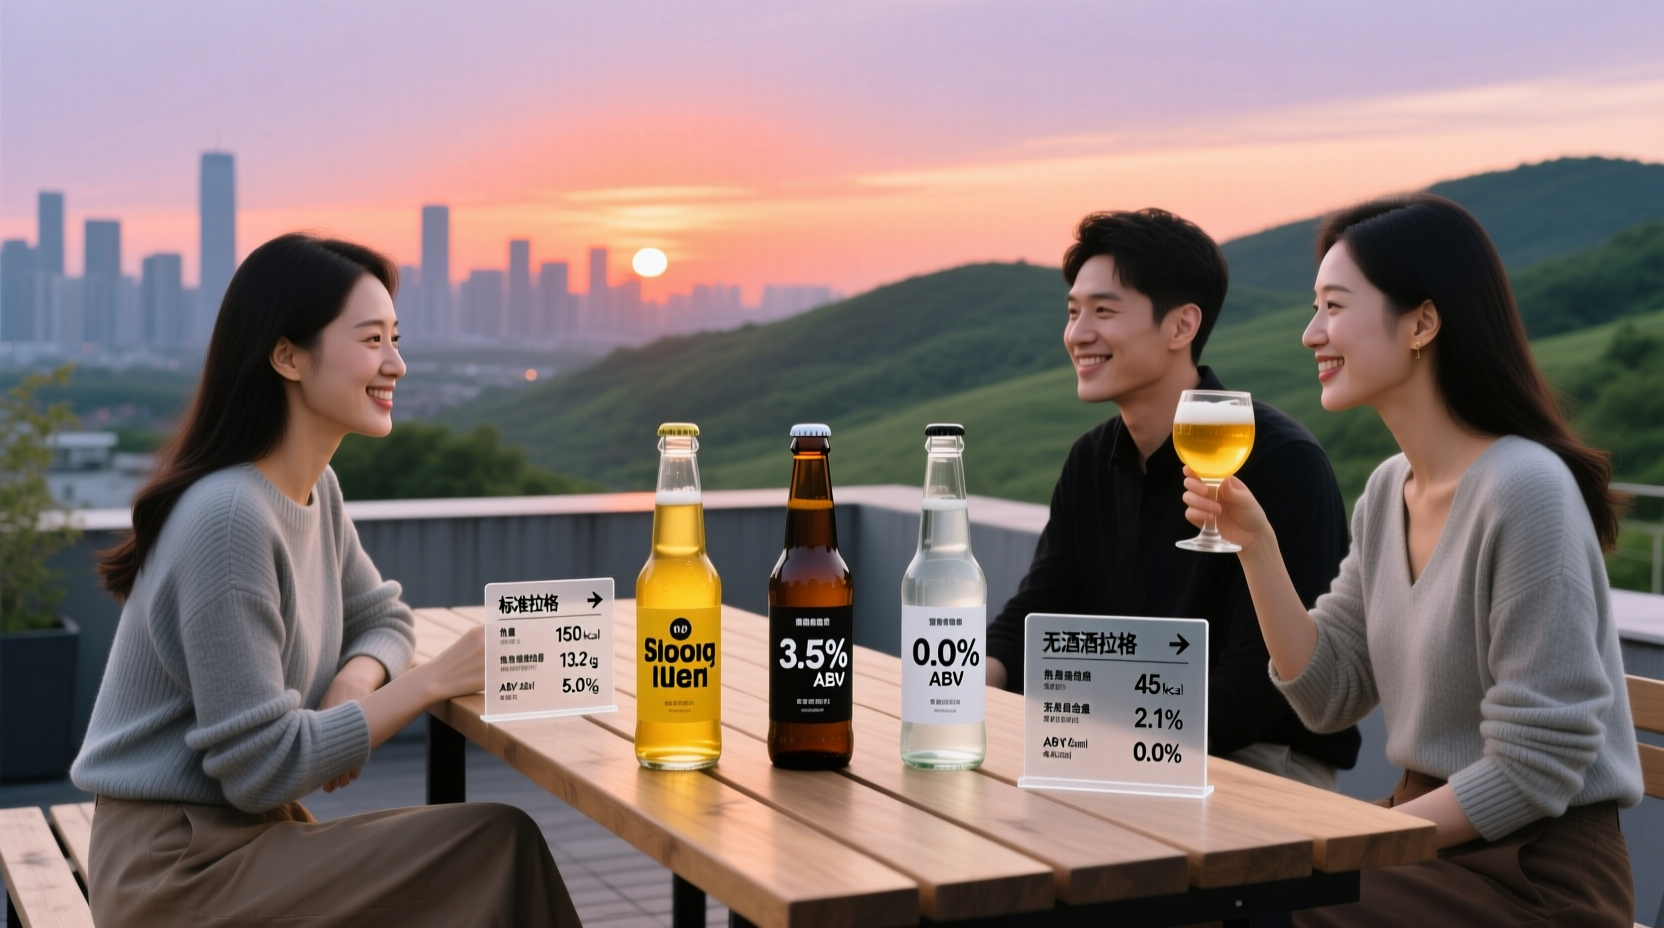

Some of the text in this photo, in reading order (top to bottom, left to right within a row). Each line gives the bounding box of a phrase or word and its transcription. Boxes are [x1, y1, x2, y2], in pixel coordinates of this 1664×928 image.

[498, 593, 559, 614] 标准拉格
[556, 626, 581, 642] 150
[560, 651, 588, 668] 13.2
[779, 638, 848, 670] 3.5%
[912, 637, 980, 667] 0.0%
[562, 677, 600, 694] 5.0%
[813, 671, 845, 688] ABV
[929, 671, 964, 687] ABV
[1134, 674, 1161, 695] 45
[1134, 707, 1184, 730] 2.1%
[1133, 741, 1182, 763] 0.0%
